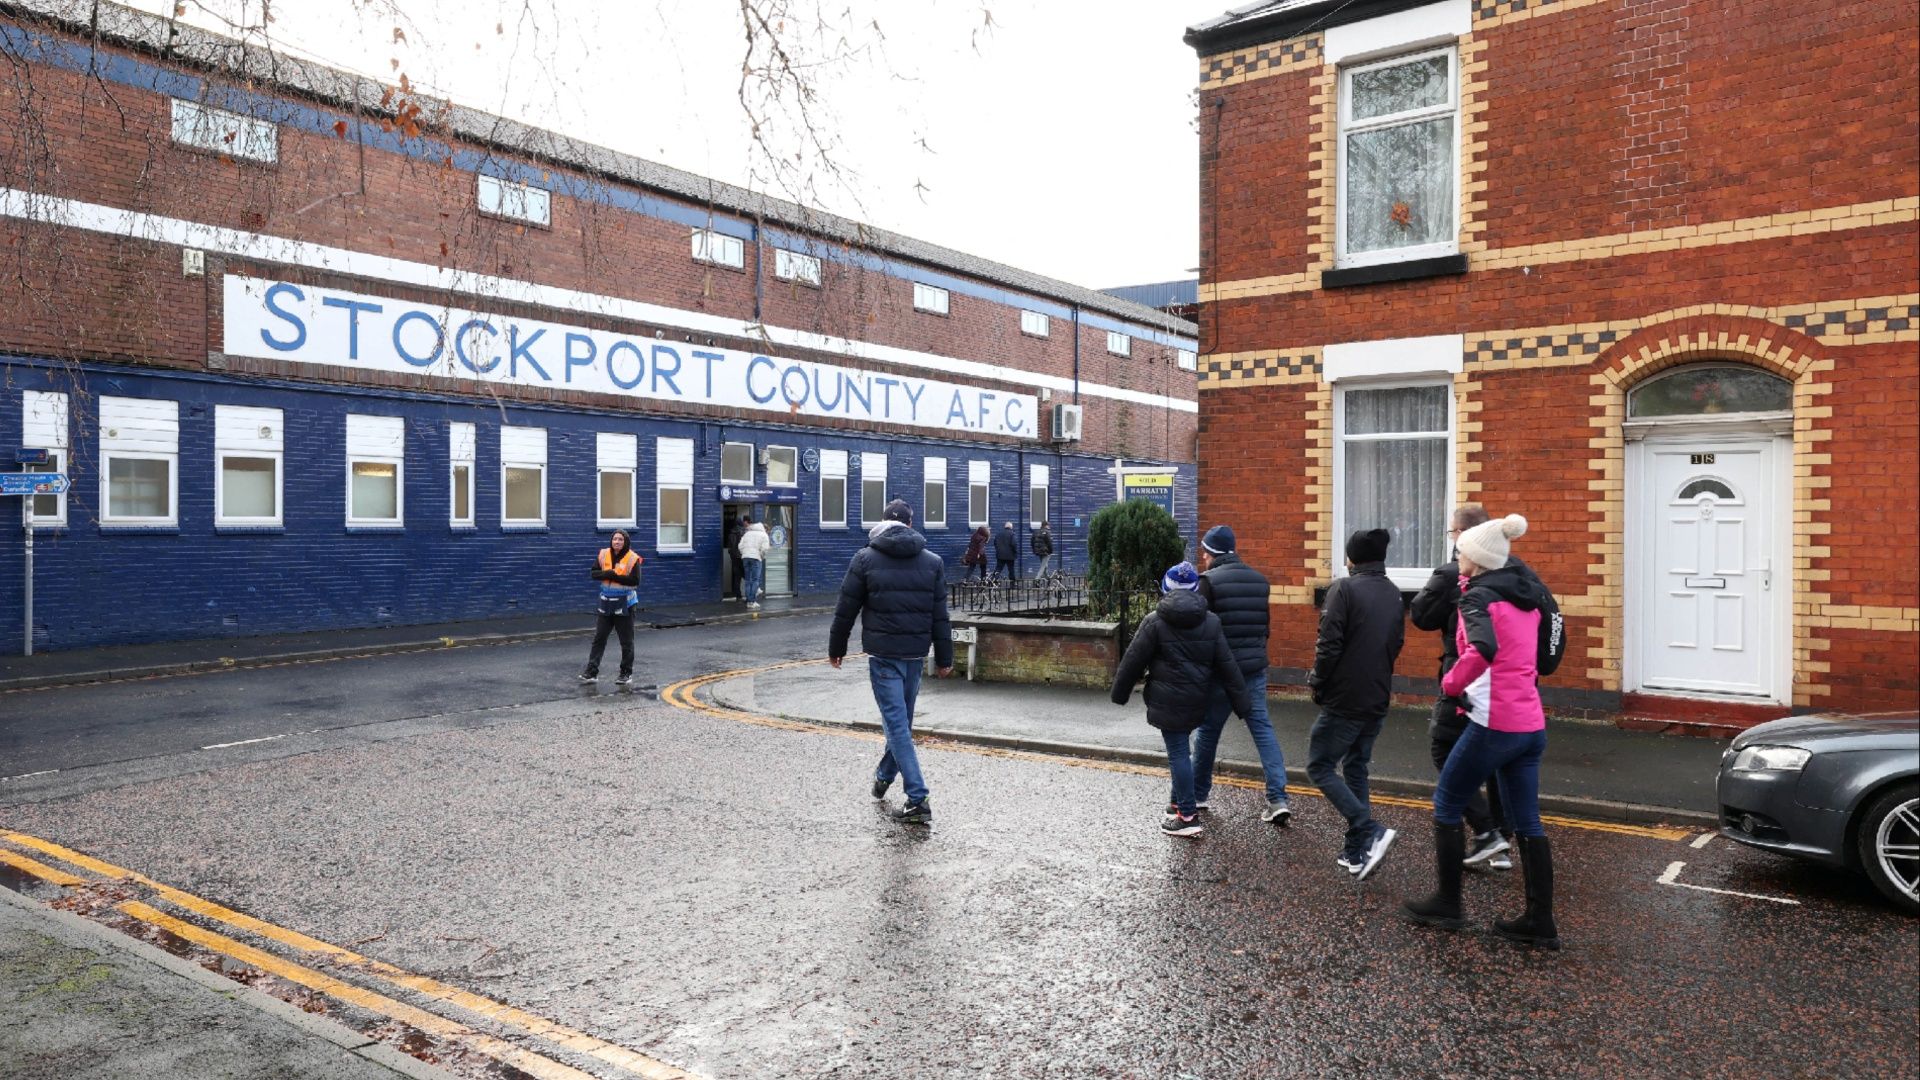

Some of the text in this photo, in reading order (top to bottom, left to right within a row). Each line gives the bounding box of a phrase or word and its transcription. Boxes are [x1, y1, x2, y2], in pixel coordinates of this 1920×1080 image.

[260, 283, 725, 398] STOCKPORT
[746, 356, 925, 421] COUNTY
[1549, 612, 1557, 656] ARMOUR
[1554, 612, 1563, 646] UNDER
